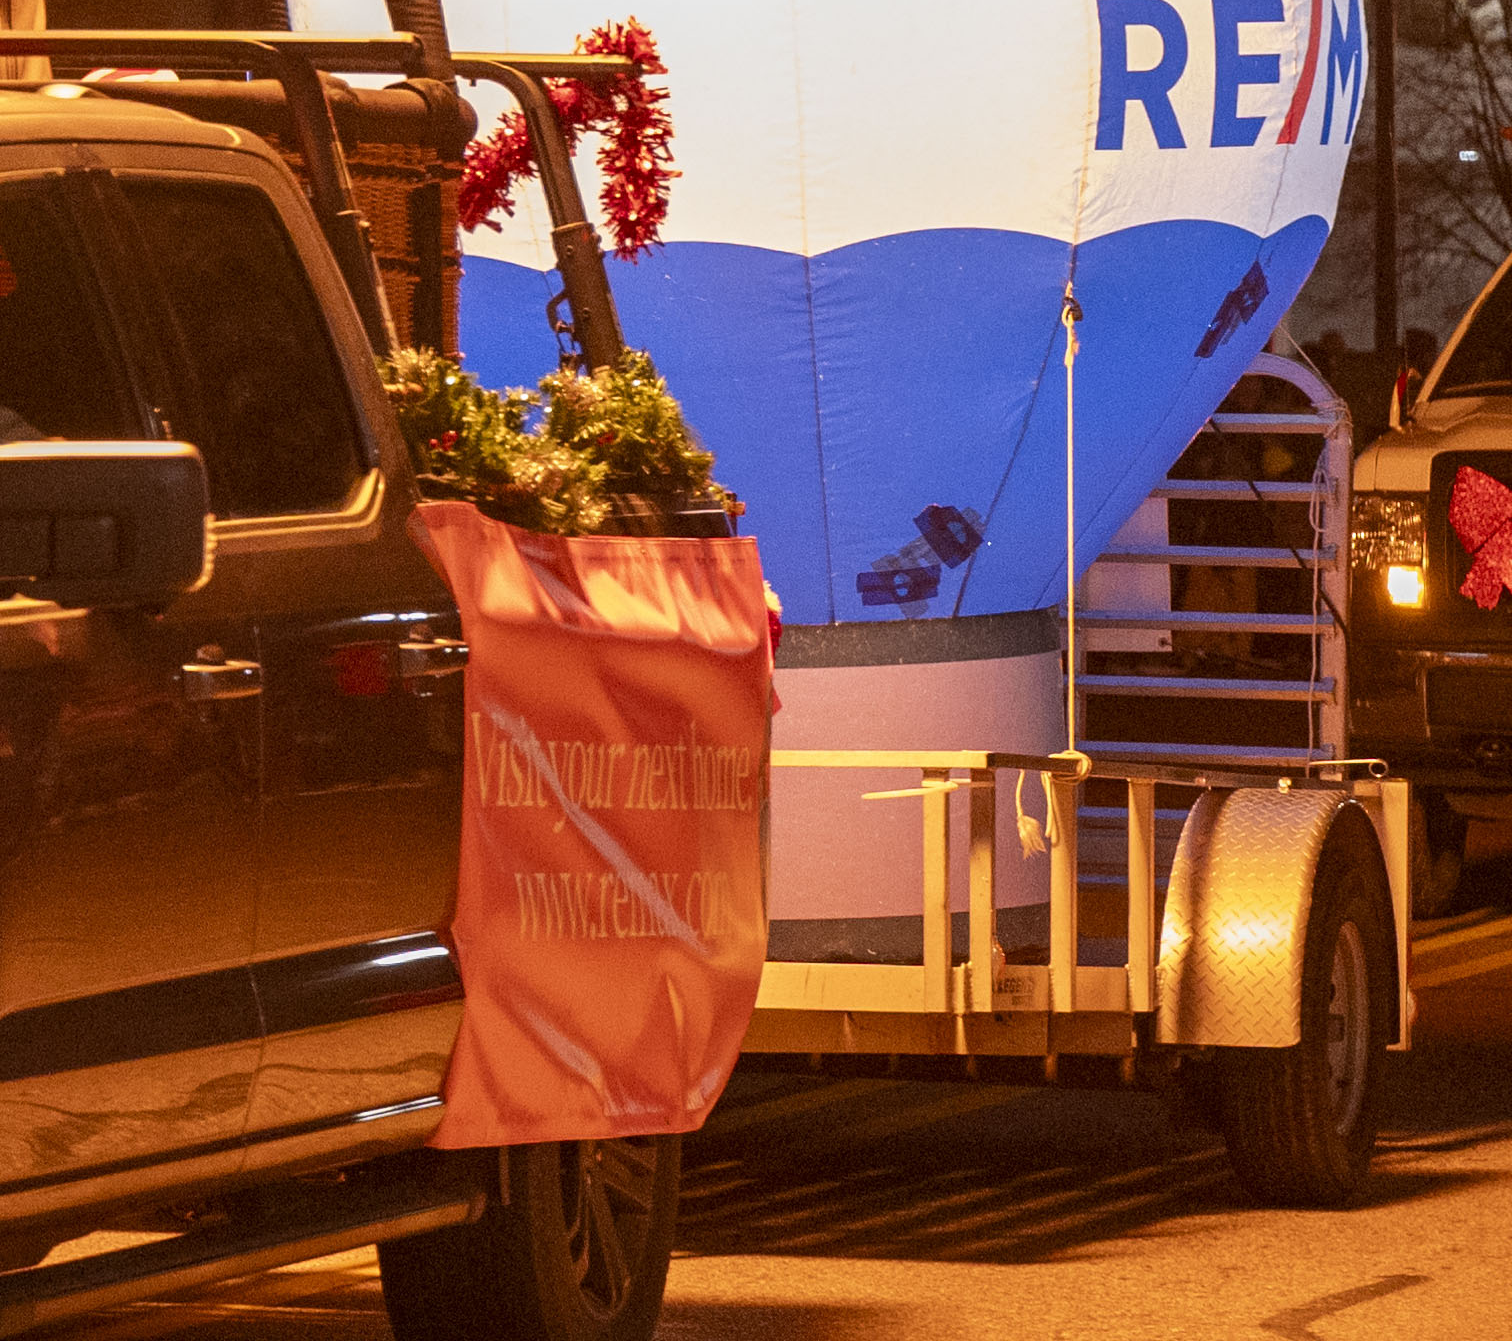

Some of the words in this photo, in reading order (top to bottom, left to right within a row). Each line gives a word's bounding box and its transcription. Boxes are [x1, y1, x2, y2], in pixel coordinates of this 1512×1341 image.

[471, 711, 548, 808] Visit
[547, 739, 626, 835] your
[624, 734, 688, 811] next
[514, 871, 728, 941] www.remxcom
